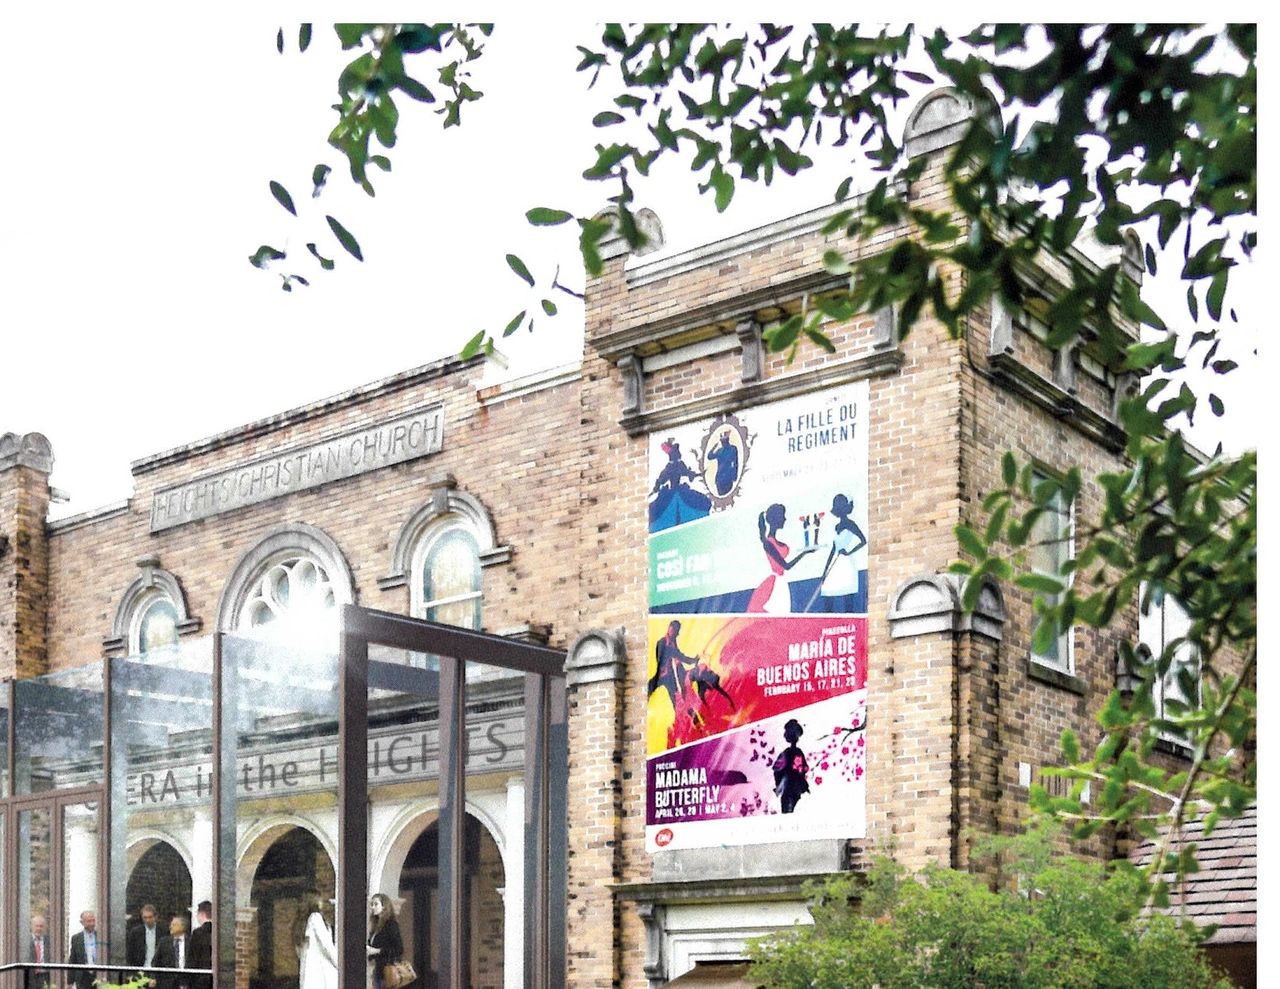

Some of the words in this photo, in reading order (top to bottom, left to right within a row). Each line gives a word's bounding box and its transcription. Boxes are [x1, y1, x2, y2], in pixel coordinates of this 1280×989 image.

[777, 418, 793, 437] LA
[798, 411, 833, 433] FILLE
[840, 403, 858, 421] DU
[788, 423, 858, 453] REGIMENT
[154, 479, 229, 519] HEIGHTS
[238, 443, 341, 498] CHRISTIAN
[349, 415, 439, 467] CHURCH
[788, 636, 833, 662] MARÍA
[838, 635, 856, 655] DE
[756, 661, 810, 686] BUENOS
[814, 656, 857, 679] AIRES
[242, 756, 299, 791] the
[655, 767, 707, 788] MADAMA
[655, 785, 720, 808] BUTTERFLY
[655, 808, 673, 819] APRIL
[705, 804, 720, 815] MAY
